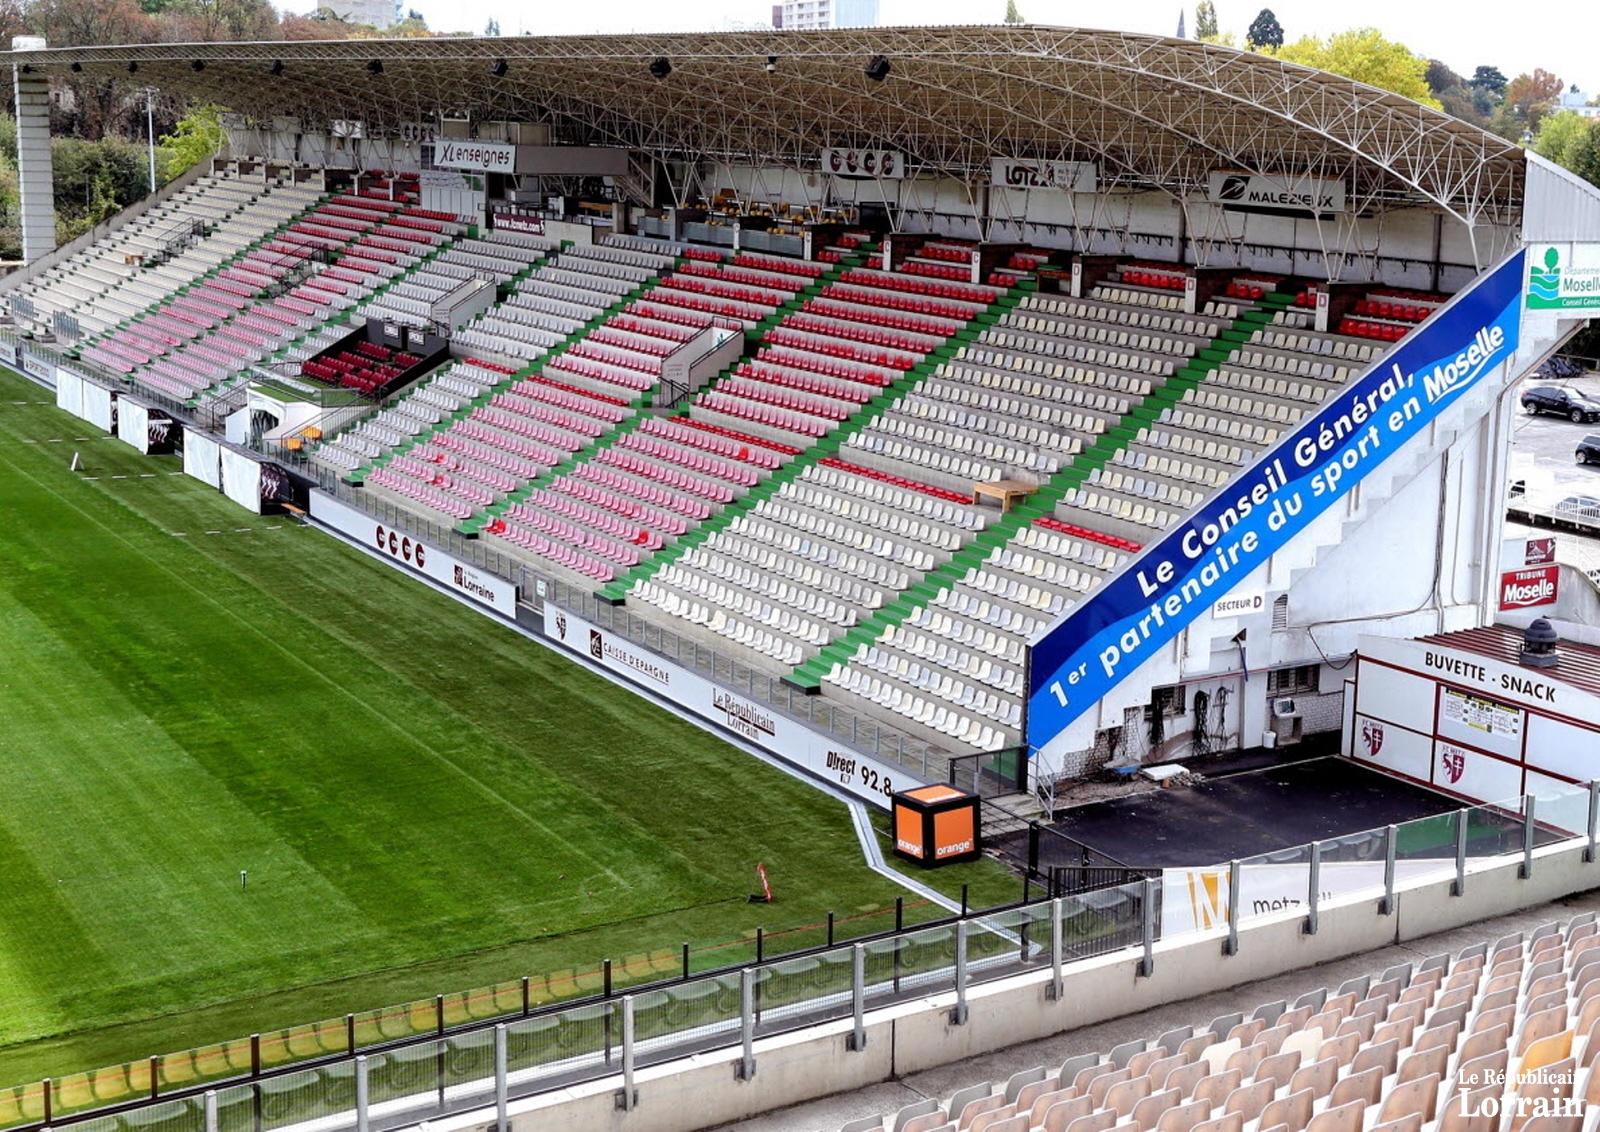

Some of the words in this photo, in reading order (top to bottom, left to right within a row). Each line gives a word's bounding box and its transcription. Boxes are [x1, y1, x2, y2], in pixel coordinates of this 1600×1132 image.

[439, 143, 454, 164] XL
[456, 145, 510, 168] enseignes
[1136, 560, 1175, 598] Le
[1182, 458, 1288, 559] Conseil
[1294, 363, 1414, 467] Général,
[1050, 661, 1088, 707] 1er
[1099, 531, 1259, 678] partenaire
[1267, 492, 1303, 531] du
[1310, 424, 1381, 498] sport
[1388, 397, 1421, 432] en
[1423, 325, 1505, 403] Moselle
[464, 576, 495, 602] Lorraine
[1515, 569, 1547, 581] TRIBUNE
[1217, 598, 1251, 611] SECTEUR
[1253, 596, 1262, 608] D
[1504, 579, 1554, 602] Moselle
[604, 643, 626, 661] CAISSE
[629, 654, 670, 682] D'EPARGNE
[1425, 651, 1485, 682] BUVETTE
[1501, 674, 1556, 703] SNACK
[713, 687, 723, 705] Le
[725, 693, 775, 732] Républicain
[727, 710, 759, 740] Lorrain
[861, 765, 893, 797] 92.8
[937, 840, 970, 855] orange
